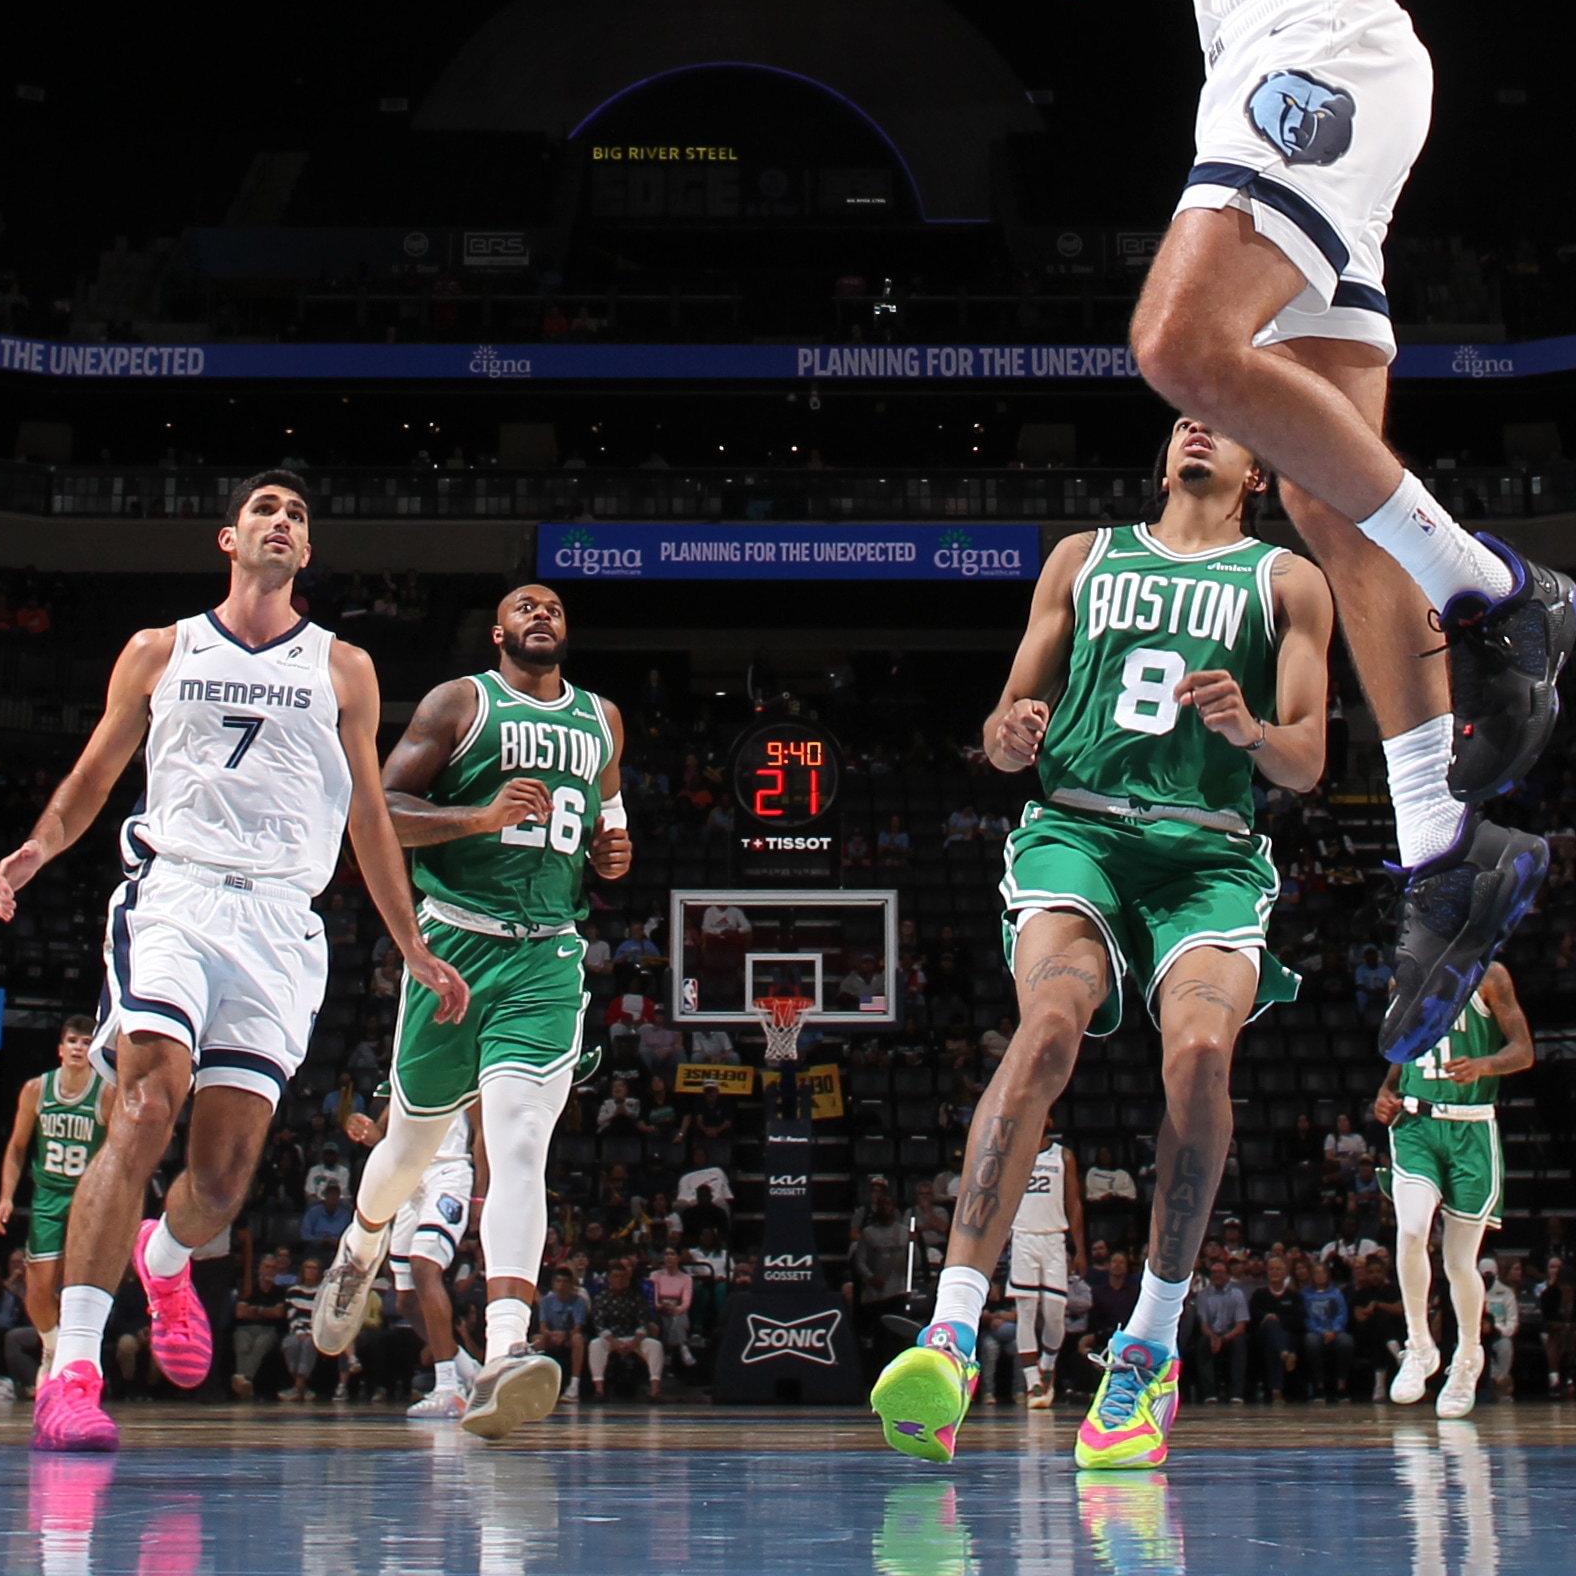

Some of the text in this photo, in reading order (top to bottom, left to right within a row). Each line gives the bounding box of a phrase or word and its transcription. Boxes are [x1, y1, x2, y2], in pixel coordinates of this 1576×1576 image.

[592, 147, 738, 161] BIG RIVER STEEL
[592, 165, 742, 217] EDGE
[0, 339, 44, 372] THE
[49, 345, 204, 376] UNEXPECTED
[469, 353, 532, 378] cigna
[797, 347, 1140, 377] PLANNING FOR THE UNEXPEC
[1451, 353, 1514, 379] cigna
[555, 542, 642, 575] cigna
[660, 541, 916, 562] PLANNING FOR THE UNEXPECTED
[933, 542, 1021, 575] cigna
[1206, 561, 1252, 573] Amica
[1088, 572, 1249, 651] BOSTON
[179, 679, 312, 709] MEMPHIS
[1113, 647, 1186, 736] 8
[222, 715, 266, 769] 7
[500, 720, 602, 785] BOSTON
[767, 742, 821, 765] 9:40
[754, 770, 819, 815] 21
[765, 837, 831, 850] TISSOT
[40, 1113, 94, 1142] BOSTON
[44, 1140, 88, 1177] 28
[769, 1187, 807, 1196] GOSSETT
[1026, 1176, 1050, 1194] 22
[764, 1271, 812, 1281] GOSSETT
[755, 1328, 826, 1348] SONIC
